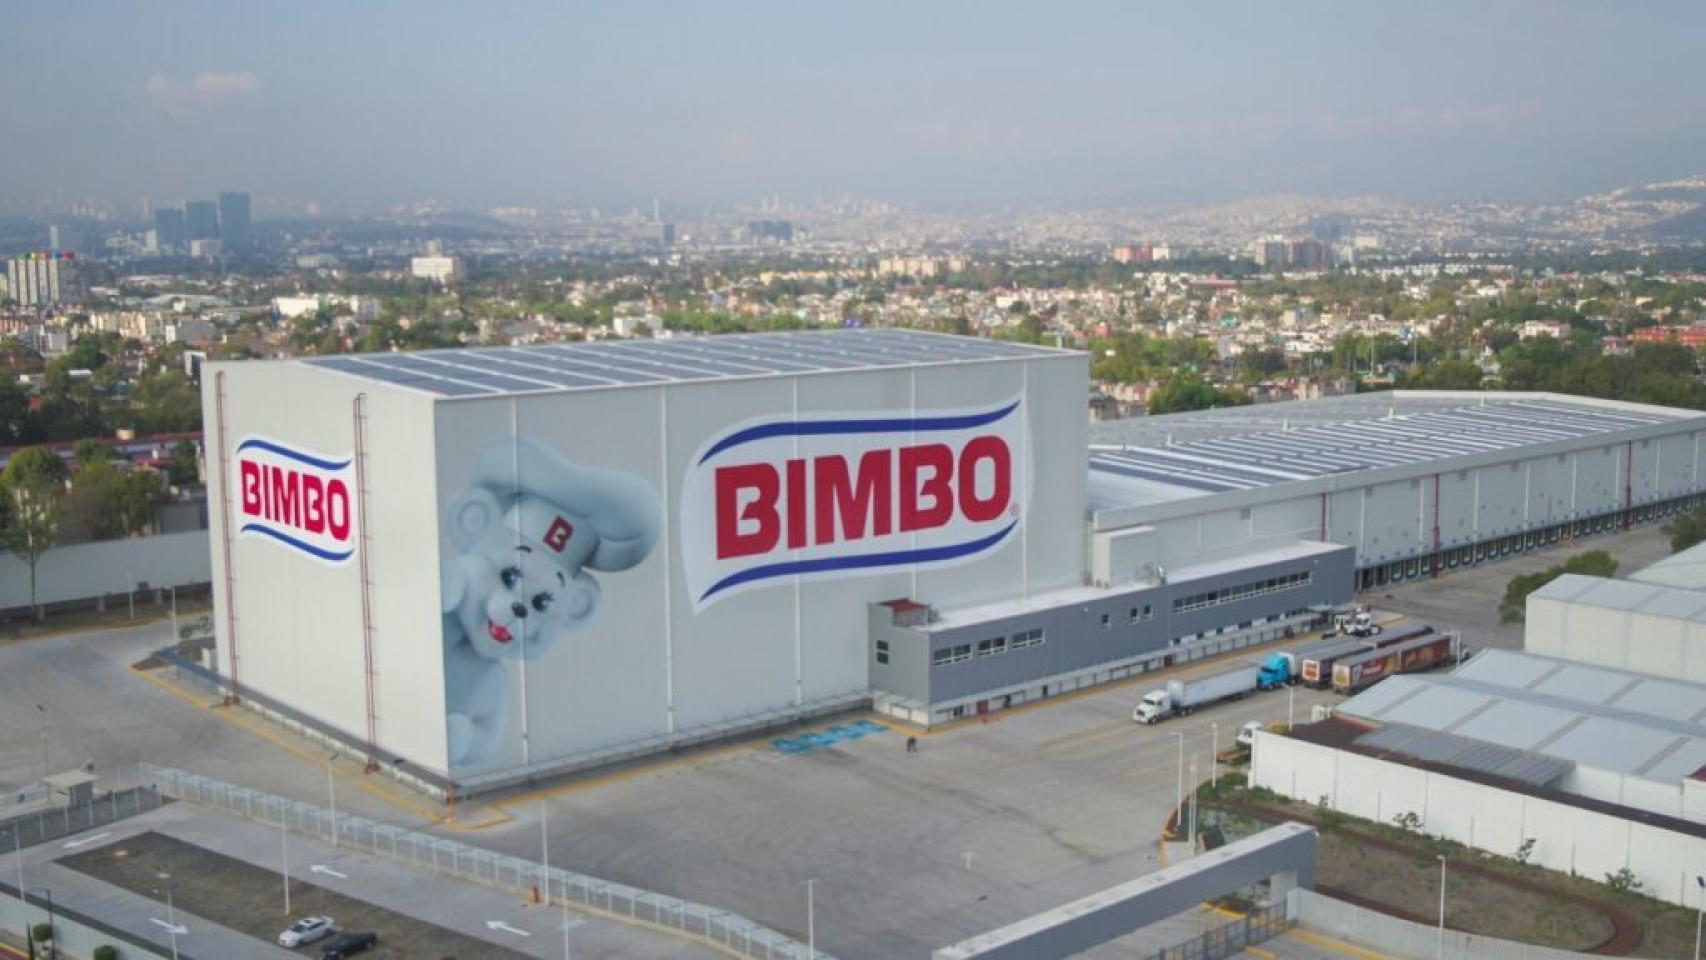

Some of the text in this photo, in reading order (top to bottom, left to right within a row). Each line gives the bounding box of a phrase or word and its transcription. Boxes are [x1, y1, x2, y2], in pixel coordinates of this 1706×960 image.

[240, 459, 349, 541] BIMBO
[542, 515, 574, 553] B
[715, 434, 1011, 560] BIMBO
